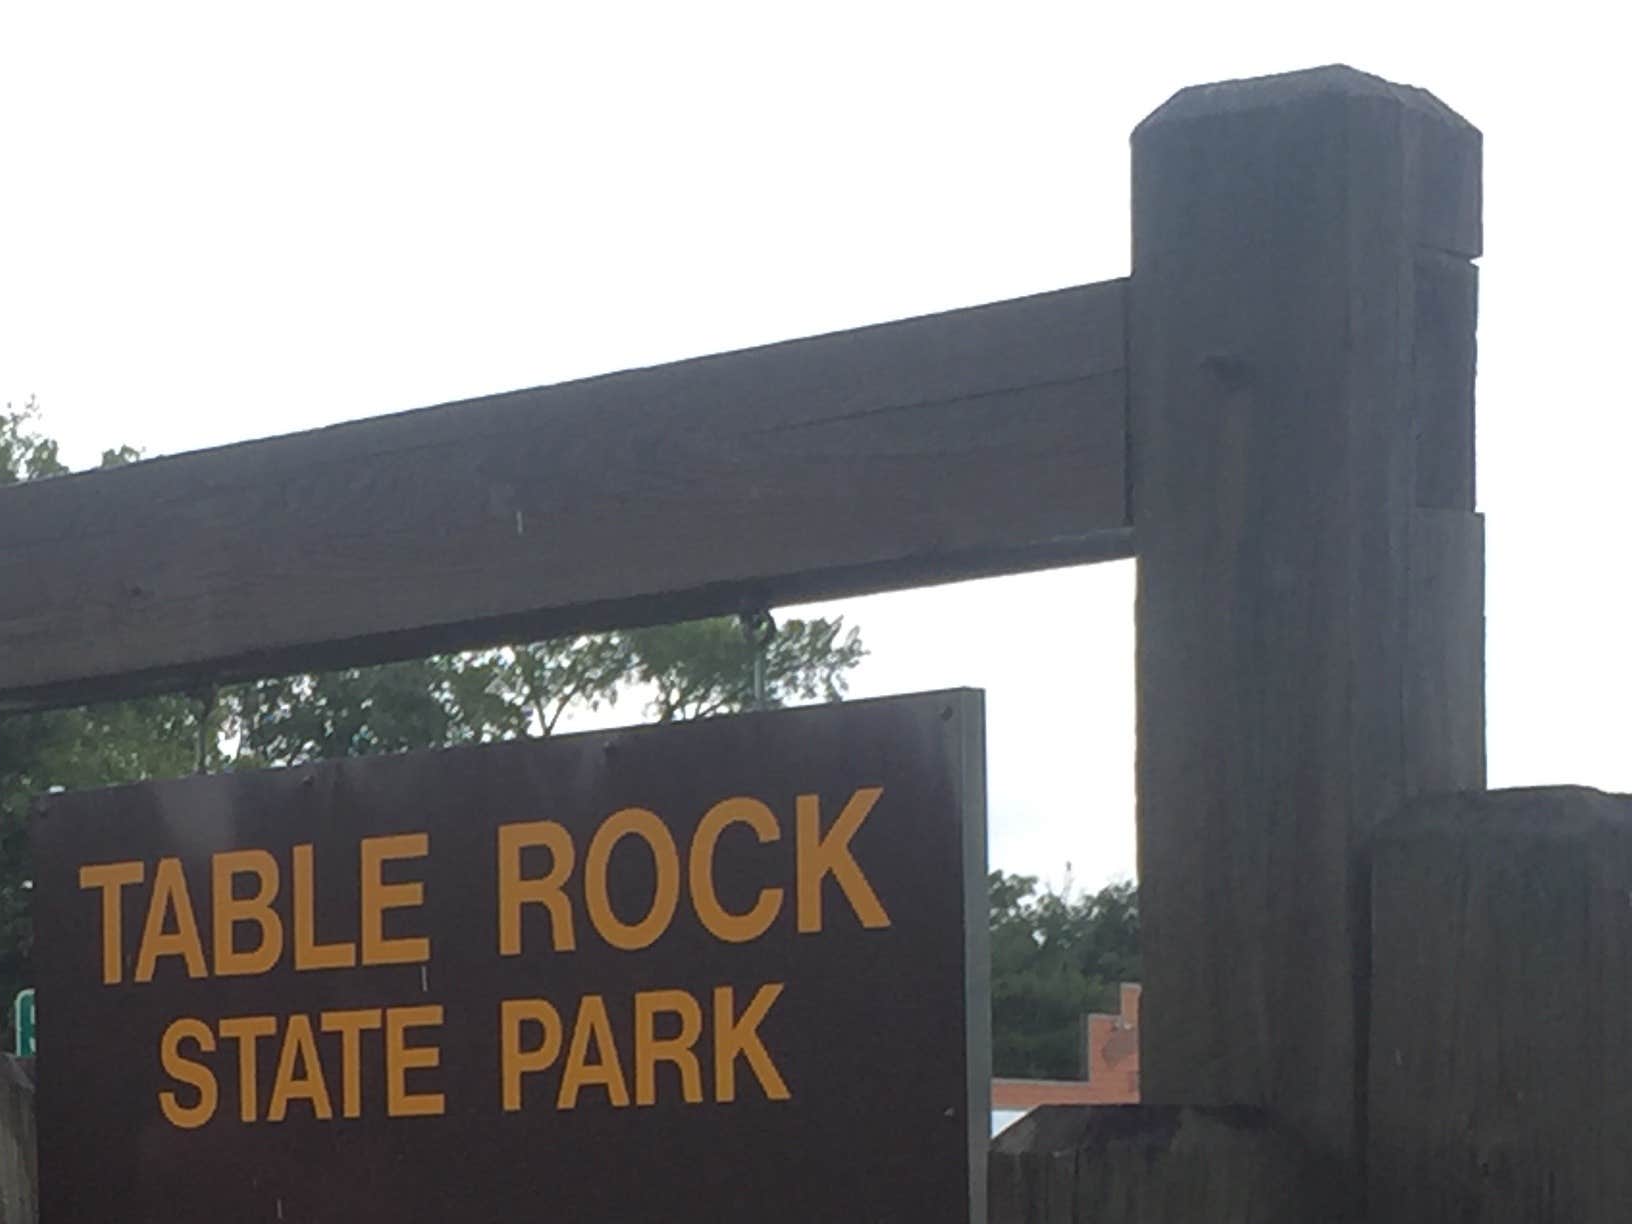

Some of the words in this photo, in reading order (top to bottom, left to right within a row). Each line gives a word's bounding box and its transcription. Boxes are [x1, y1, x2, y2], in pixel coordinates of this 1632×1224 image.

[79, 832, 431, 985] TABLE
[497, 787, 892, 955] ROCK
[158, 1004, 446, 1128] STATE
[500, 982, 792, 1111] PARK
